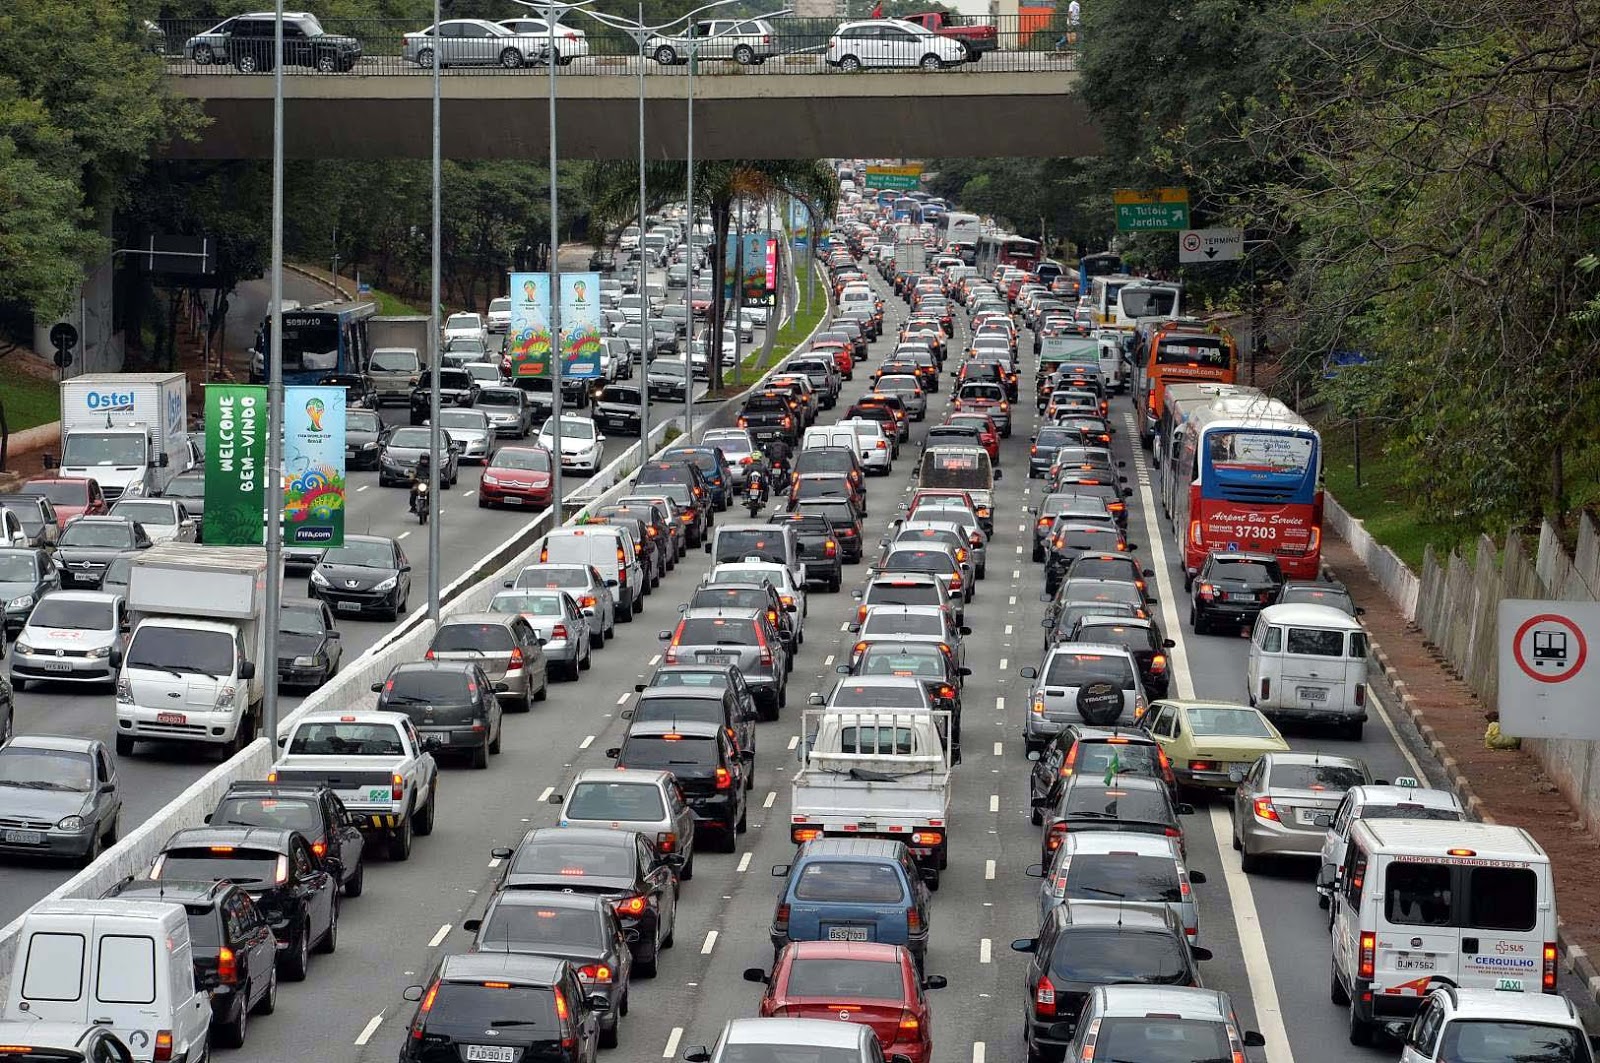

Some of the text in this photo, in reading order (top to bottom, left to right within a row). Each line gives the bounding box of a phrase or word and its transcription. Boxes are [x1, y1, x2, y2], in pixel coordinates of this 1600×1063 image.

[1121, 207, 1131, 216] R.
[1130, 218, 1168, 227] Jardins
[87, 391, 135, 409] Ostel
[219, 396, 234, 472] WELCOME
[240, 396, 256, 492] BEM-VINDO
[1210, 511, 1303, 525] Airport Bus Service
[1235, 525, 1276, 539] 37303
[1400, 778, 1415, 788] TAXI
[1475, 956, 1534, 967] CERQUILHO
[1500, 979, 1521, 990] TAXI
